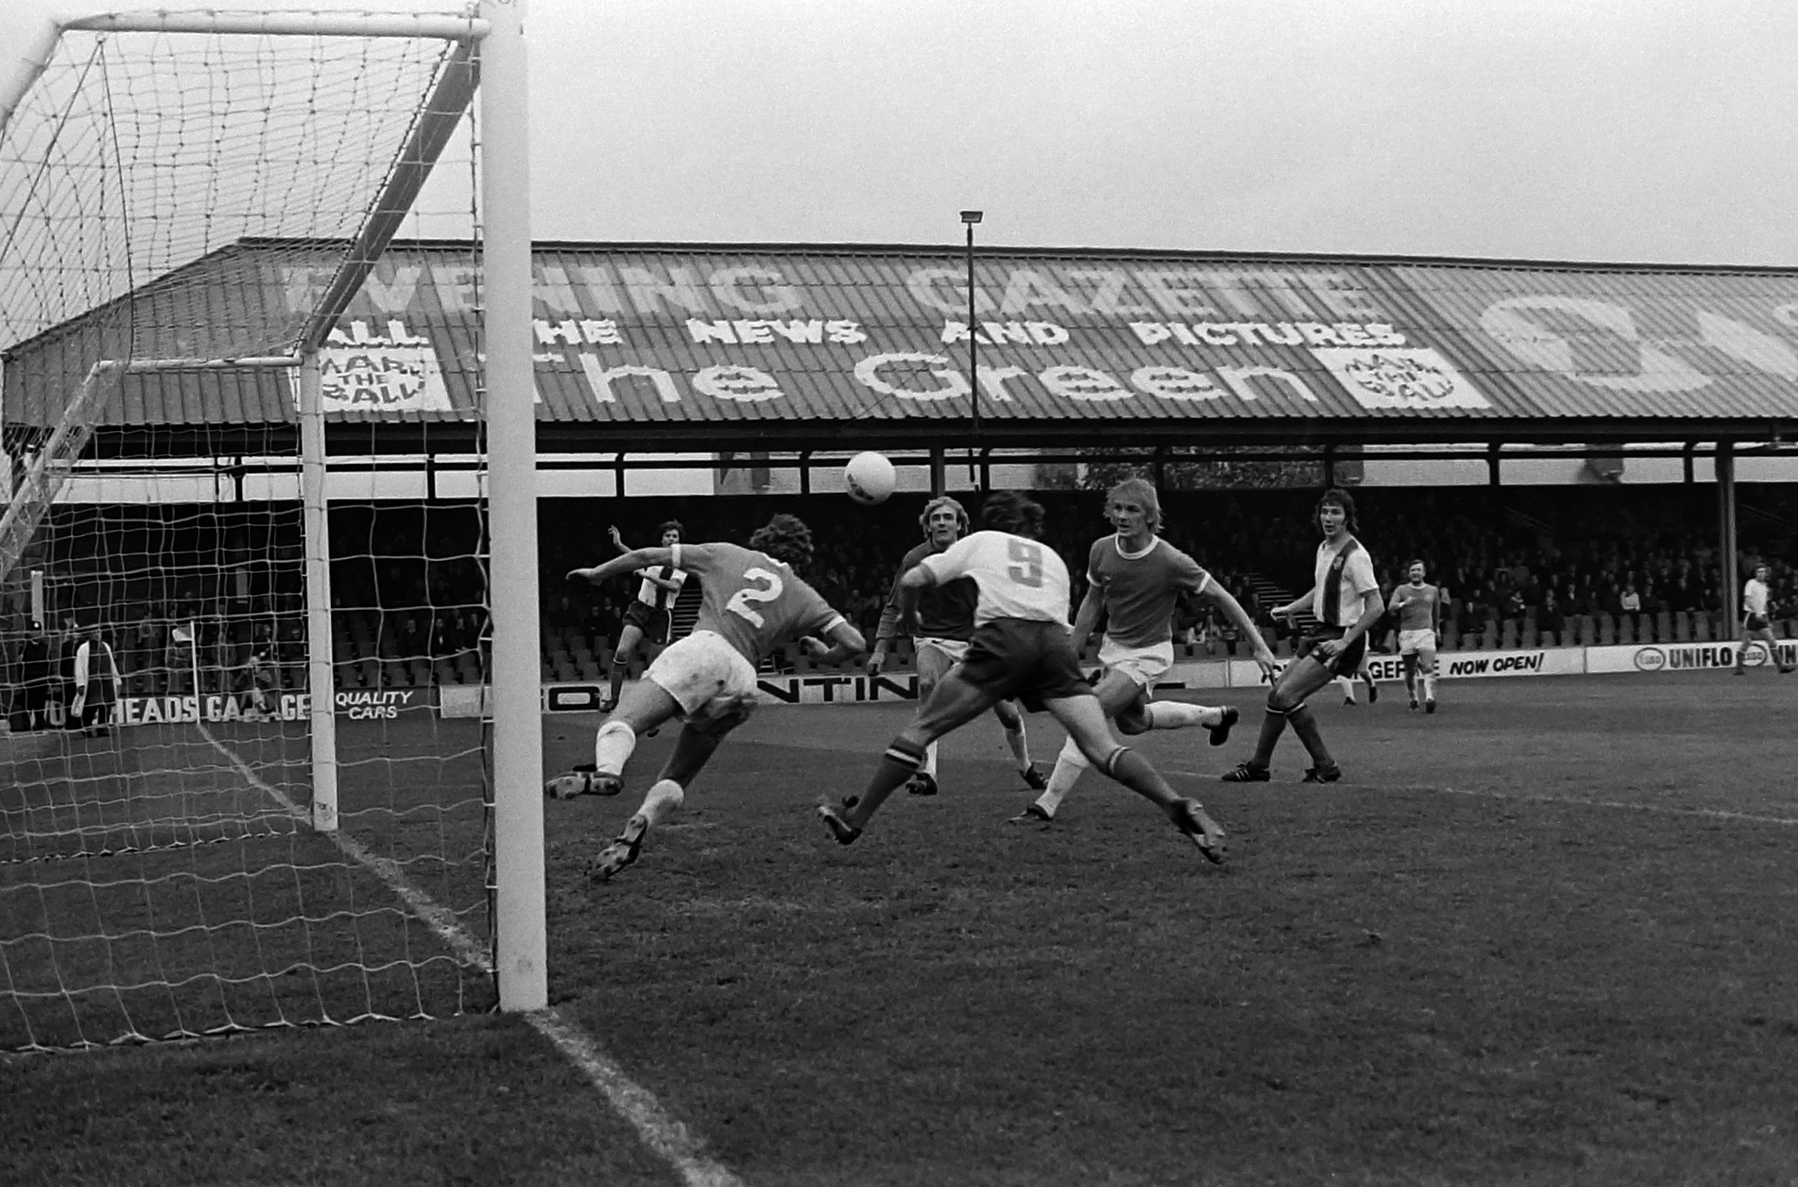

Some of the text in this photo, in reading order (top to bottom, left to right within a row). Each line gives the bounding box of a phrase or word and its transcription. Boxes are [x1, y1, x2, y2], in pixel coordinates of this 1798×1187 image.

[906, 268, 1386, 316] GAZETTE
[531, 318, 624, 345] HE
[685, 318, 867, 345] NEWS
[941, 319, 1069, 346] AND
[1129, 321, 1406, 346] PICTURES
[854, 351, 1320, 401] Green
[1006, 537, 1043, 588] 9
[726, 567, 783, 629] 2
[1449, 659, 1490, 676] NOW
[1492, 652, 1545, 673] OPEN!
[1669, 646, 1733, 669] UNIFLO
[336, 691, 414, 708] QUALITY
[349, 705, 398, 720] CARS
